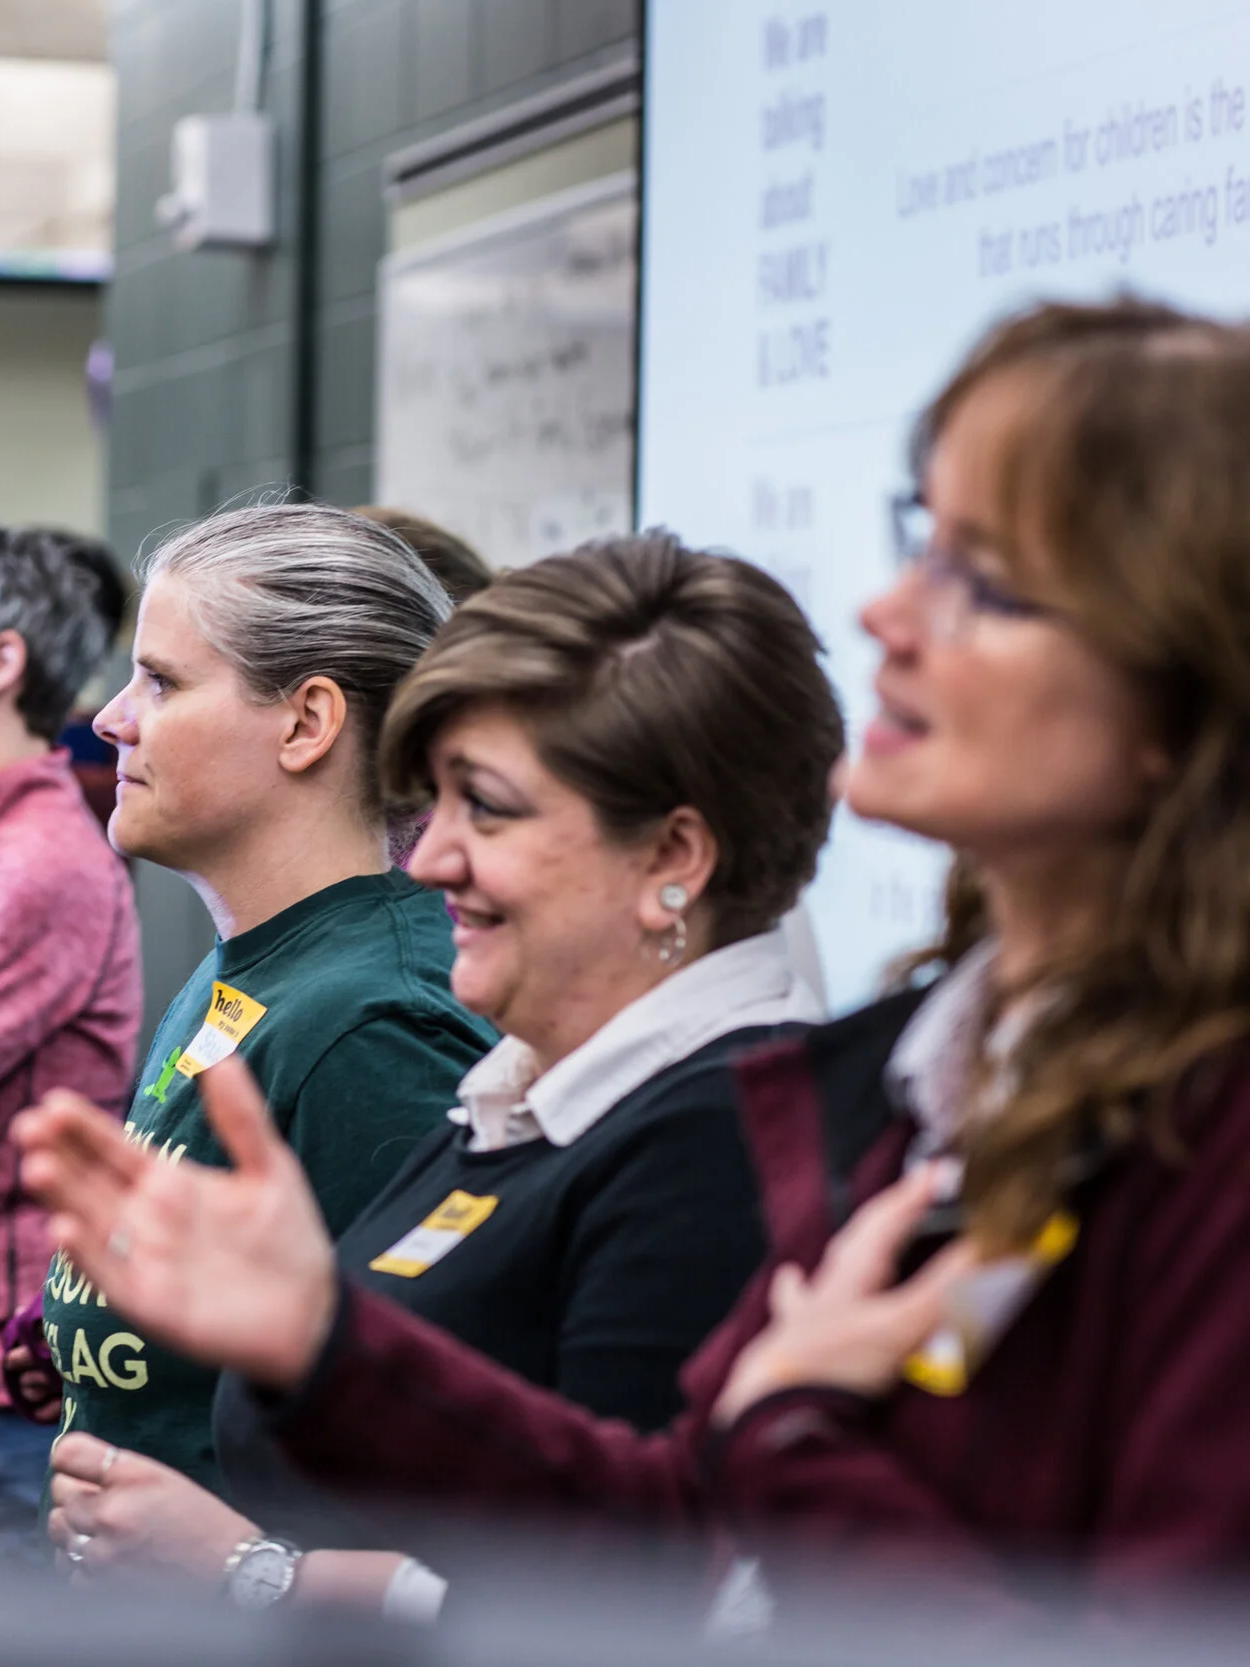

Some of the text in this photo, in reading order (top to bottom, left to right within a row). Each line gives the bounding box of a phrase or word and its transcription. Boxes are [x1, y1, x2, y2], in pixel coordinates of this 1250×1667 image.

[896, 77, 1246, 218] Love and concern for children is the
[977, 224, 1014, 278] that
[1018, 220, 1061, 268] runs
[1066, 195, 1146, 266] through
[1152, 178, 1218, 247] caring
[214, 989, 244, 1022] hello
